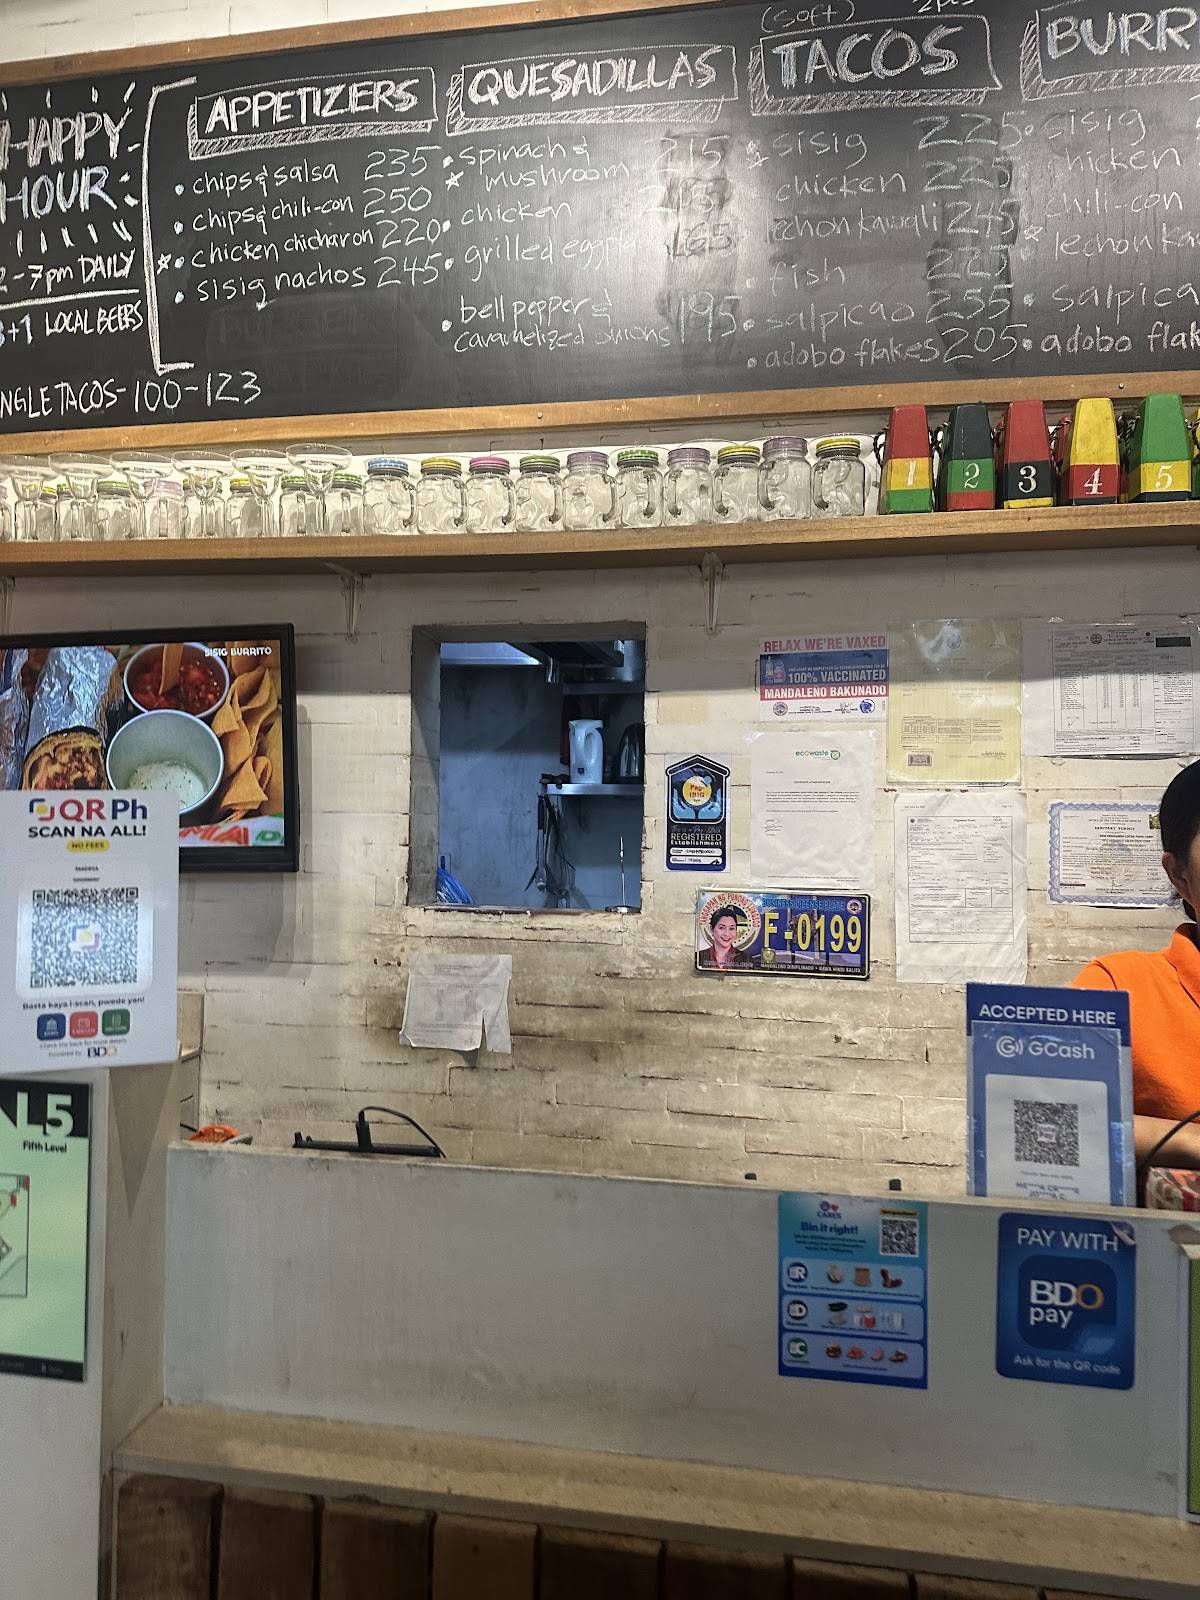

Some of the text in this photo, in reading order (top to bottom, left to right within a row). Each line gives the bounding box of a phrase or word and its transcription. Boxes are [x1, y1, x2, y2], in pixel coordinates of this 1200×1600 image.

[773, 24, 963, 90] TACOS
[468, 45, 722, 105] QUESADILLAS
[205, 79, 420, 133] APPETIZERS
[0, 107, 132, 170] HAPPY
[1046, 108, 1147, 146] sisig
[459, 136, 566, 173] spinach
[773, 130, 867, 169] sisig
[274, 158, 339, 187] salsa
[365, 146, 441, 180] 235
[485, 163, 629, 192] mushroom
[0, 166, 117, 224] HOUR
[776, 173, 906, 201] chicken
[363, 186, 432, 218] 250
[461, 201, 571, 224] chicken
[946, 199, 1022, 237] 245
[191, 218, 441, 268] chicken chicharon 220
[1055, 230, 1152, 260] lechon
[78, 248, 136, 284] DAILY
[465, 234, 553, 282] grilled
[197, 253, 442, 311] sisig nachos 245
[769, 257, 846, 296] fish
[45, 309, 94, 336] LOCAL
[97, 300, 144, 334] BEERS
[460, 295, 504, 324] bell
[680, 292, 742, 343] 195
[766, 302, 915, 342] salpicao
[765, 323, 1027, 368] adobo flakes 205
[1041, 324, 1132, 356] adobo
[905, 461, 917, 486] 1
[964, 462, 979, 489] 2
[1018, 465, 1037, 493] 3
[1083, 467, 1104, 495] 4
[1155, 464, 1173, 490] 5
[205, 646, 272, 657] SISIG BURRITO
[764, 635, 886, 653] RELAX WE'RE VAXED
[787, 669, 887, 684] 100% VACCINATED
[830, 685, 887, 697] BAKUNADO
[796, 749, 829, 757] ecowaste
[60, 798, 148, 822] QR Ph
[28, 825, 147, 838] SCAN NA ALL!
[72, 840, 105, 849] NO FEES
[671, 833, 722, 841] REGISTERED
[762, 898, 845, 911] BUSINESS LICENSE PLATE
[979, 1004, 1116, 1025] ACCEPTED HERE
[87, 1047, 118, 1058] BDO
[1028, 1041, 1095, 1060] GCash
[23, 1140, 67, 1153] Fifth Level
[800, 1221, 858, 1236] Bin it right!
[1017, 1228, 1119, 1251] PAY WITH
[1030, 1280, 1105, 1310] BDO
[1030, 1307, 1074, 1329] pay
[1072, 1360, 1092, 1372] QR
